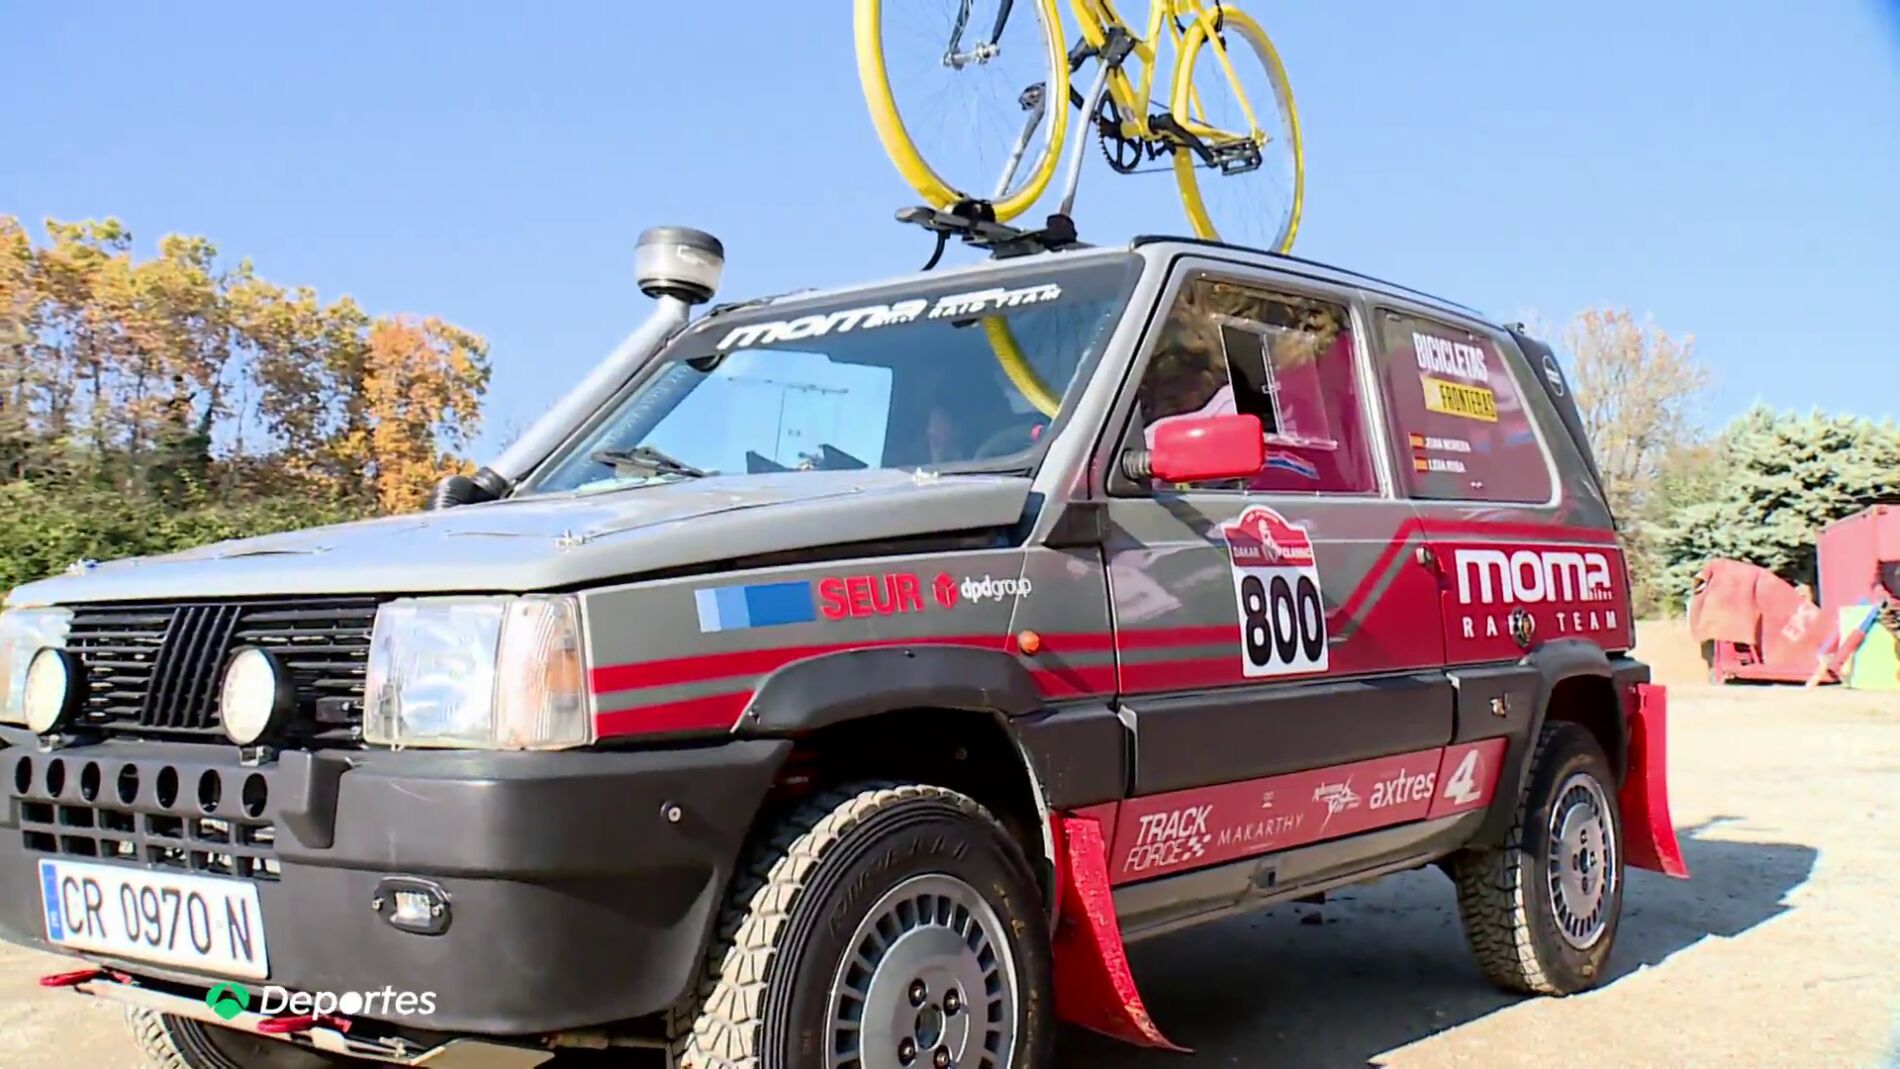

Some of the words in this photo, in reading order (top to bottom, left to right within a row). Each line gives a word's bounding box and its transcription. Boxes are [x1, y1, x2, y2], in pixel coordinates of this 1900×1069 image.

[716, 299, 928, 350] moma
[1412, 332, 1488, 383] BICICLETAS
[1439, 384, 1495, 417] FRONTERAS
[1233, 546, 1260, 558] DAKAR
[818, 571, 926, 622] SEUR
[960, 574, 1033, 604] dpdgroup
[1454, 548, 1612, 604] moma
[1241, 575, 1324, 667] 800
[1556, 610, 1618, 633] TEAM
[1369, 768, 1436, 810] axtres
[1443, 749, 1483, 806] 4
[1136, 804, 1214, 846] TRACK
[1217, 813, 1305, 847] MAKARTHY
[1123, 838, 1187, 873] FORCE
[61, 876, 107, 939] CR
[119, 882, 212, 955] 0970
[225, 896, 254, 963] N
